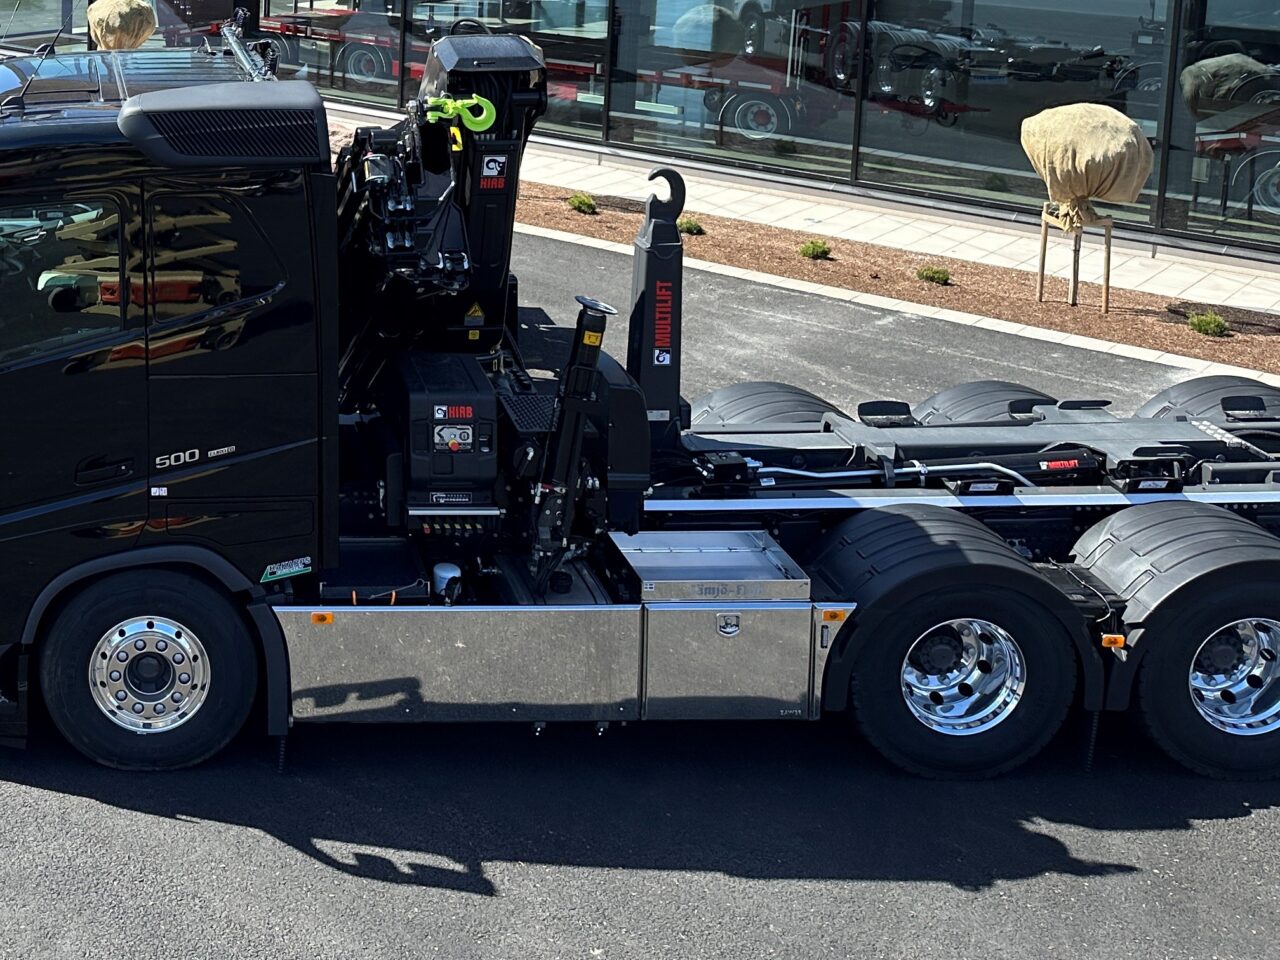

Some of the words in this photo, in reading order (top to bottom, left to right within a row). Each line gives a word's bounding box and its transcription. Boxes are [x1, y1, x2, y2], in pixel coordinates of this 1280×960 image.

[480, 178, 505, 189] HIAB
[655, 281, 673, 347] MULTILIFT
[448, 406, 473, 418] HIAB
[155, 449, 200, 469] 500
[267, 556, 312, 573] HAKARPS
